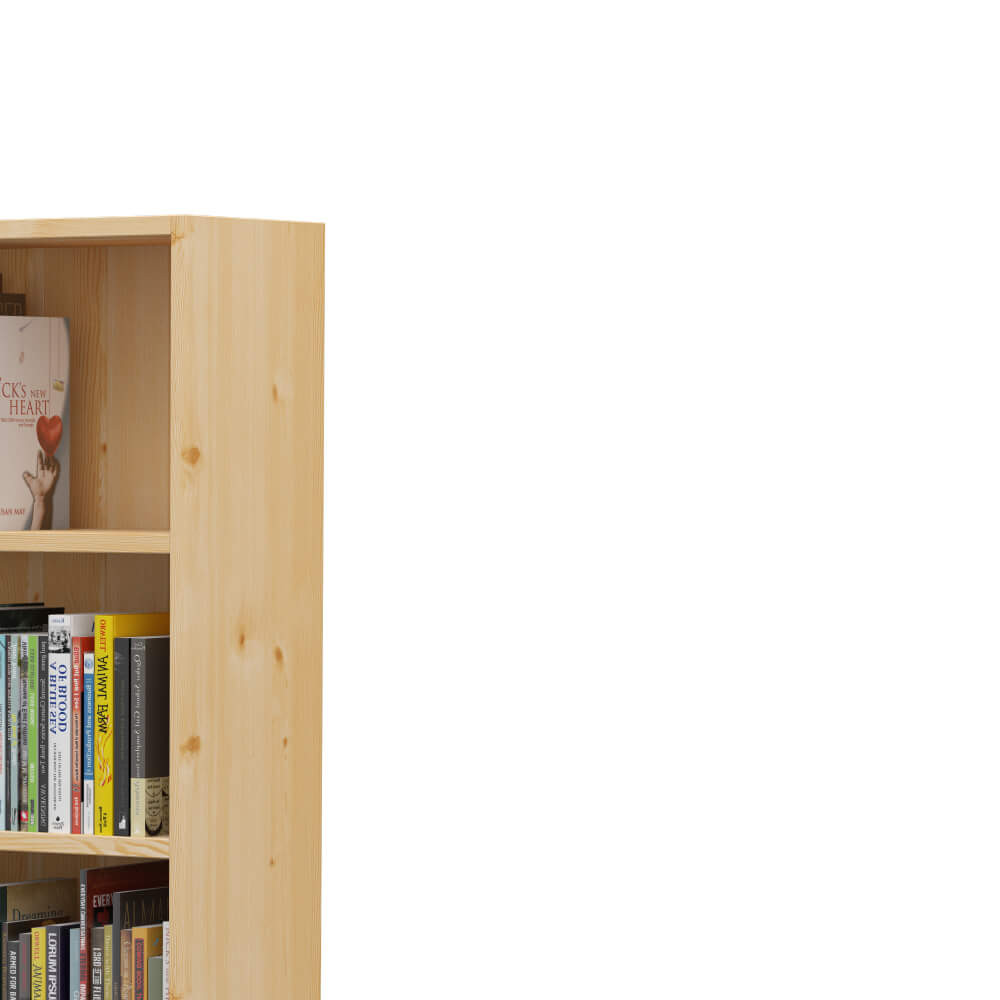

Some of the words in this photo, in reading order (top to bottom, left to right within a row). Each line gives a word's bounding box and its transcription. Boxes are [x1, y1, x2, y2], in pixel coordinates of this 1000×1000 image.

[31, 390, 46, 398] NEW
[10, 400, 49, 415] HEART
[48, 933, 56, 972] LORUM
[9, 951, 17, 974] ARMED
[9, 976, 17, 988] FOR
